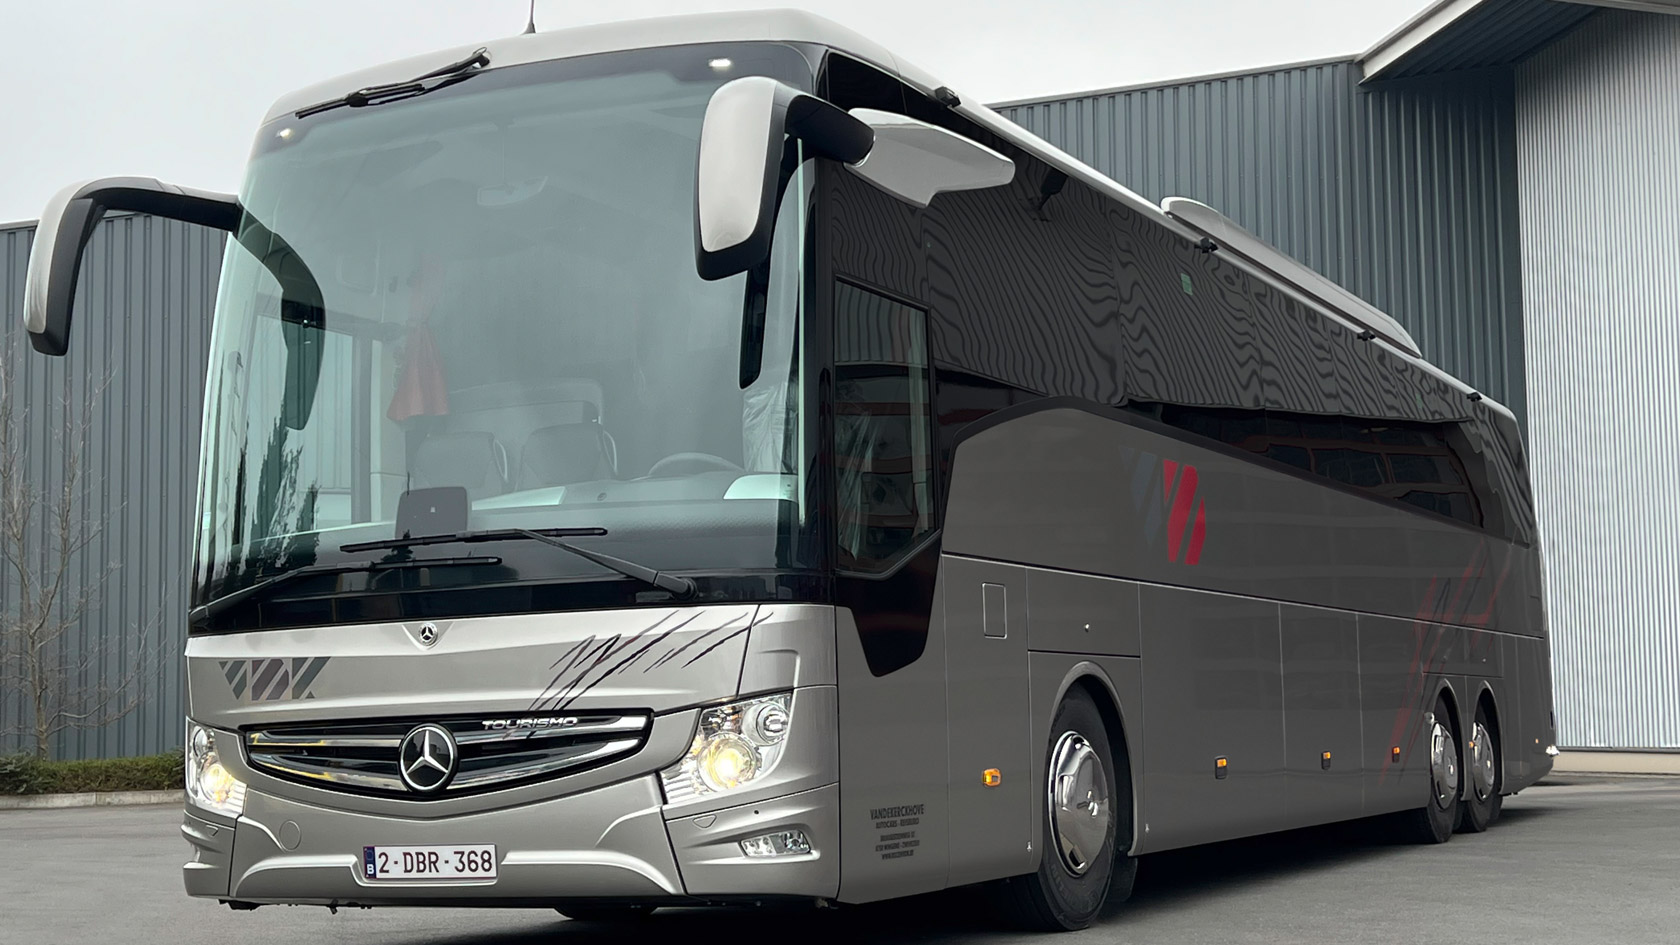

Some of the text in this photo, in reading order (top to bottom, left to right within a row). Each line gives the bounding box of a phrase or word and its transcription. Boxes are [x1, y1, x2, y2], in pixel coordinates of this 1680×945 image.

[482, 717, 577, 730] TOURISMO
[870, 803, 925, 820] VANDEKERCKHOVE
[367, 863, 375, 875] B
